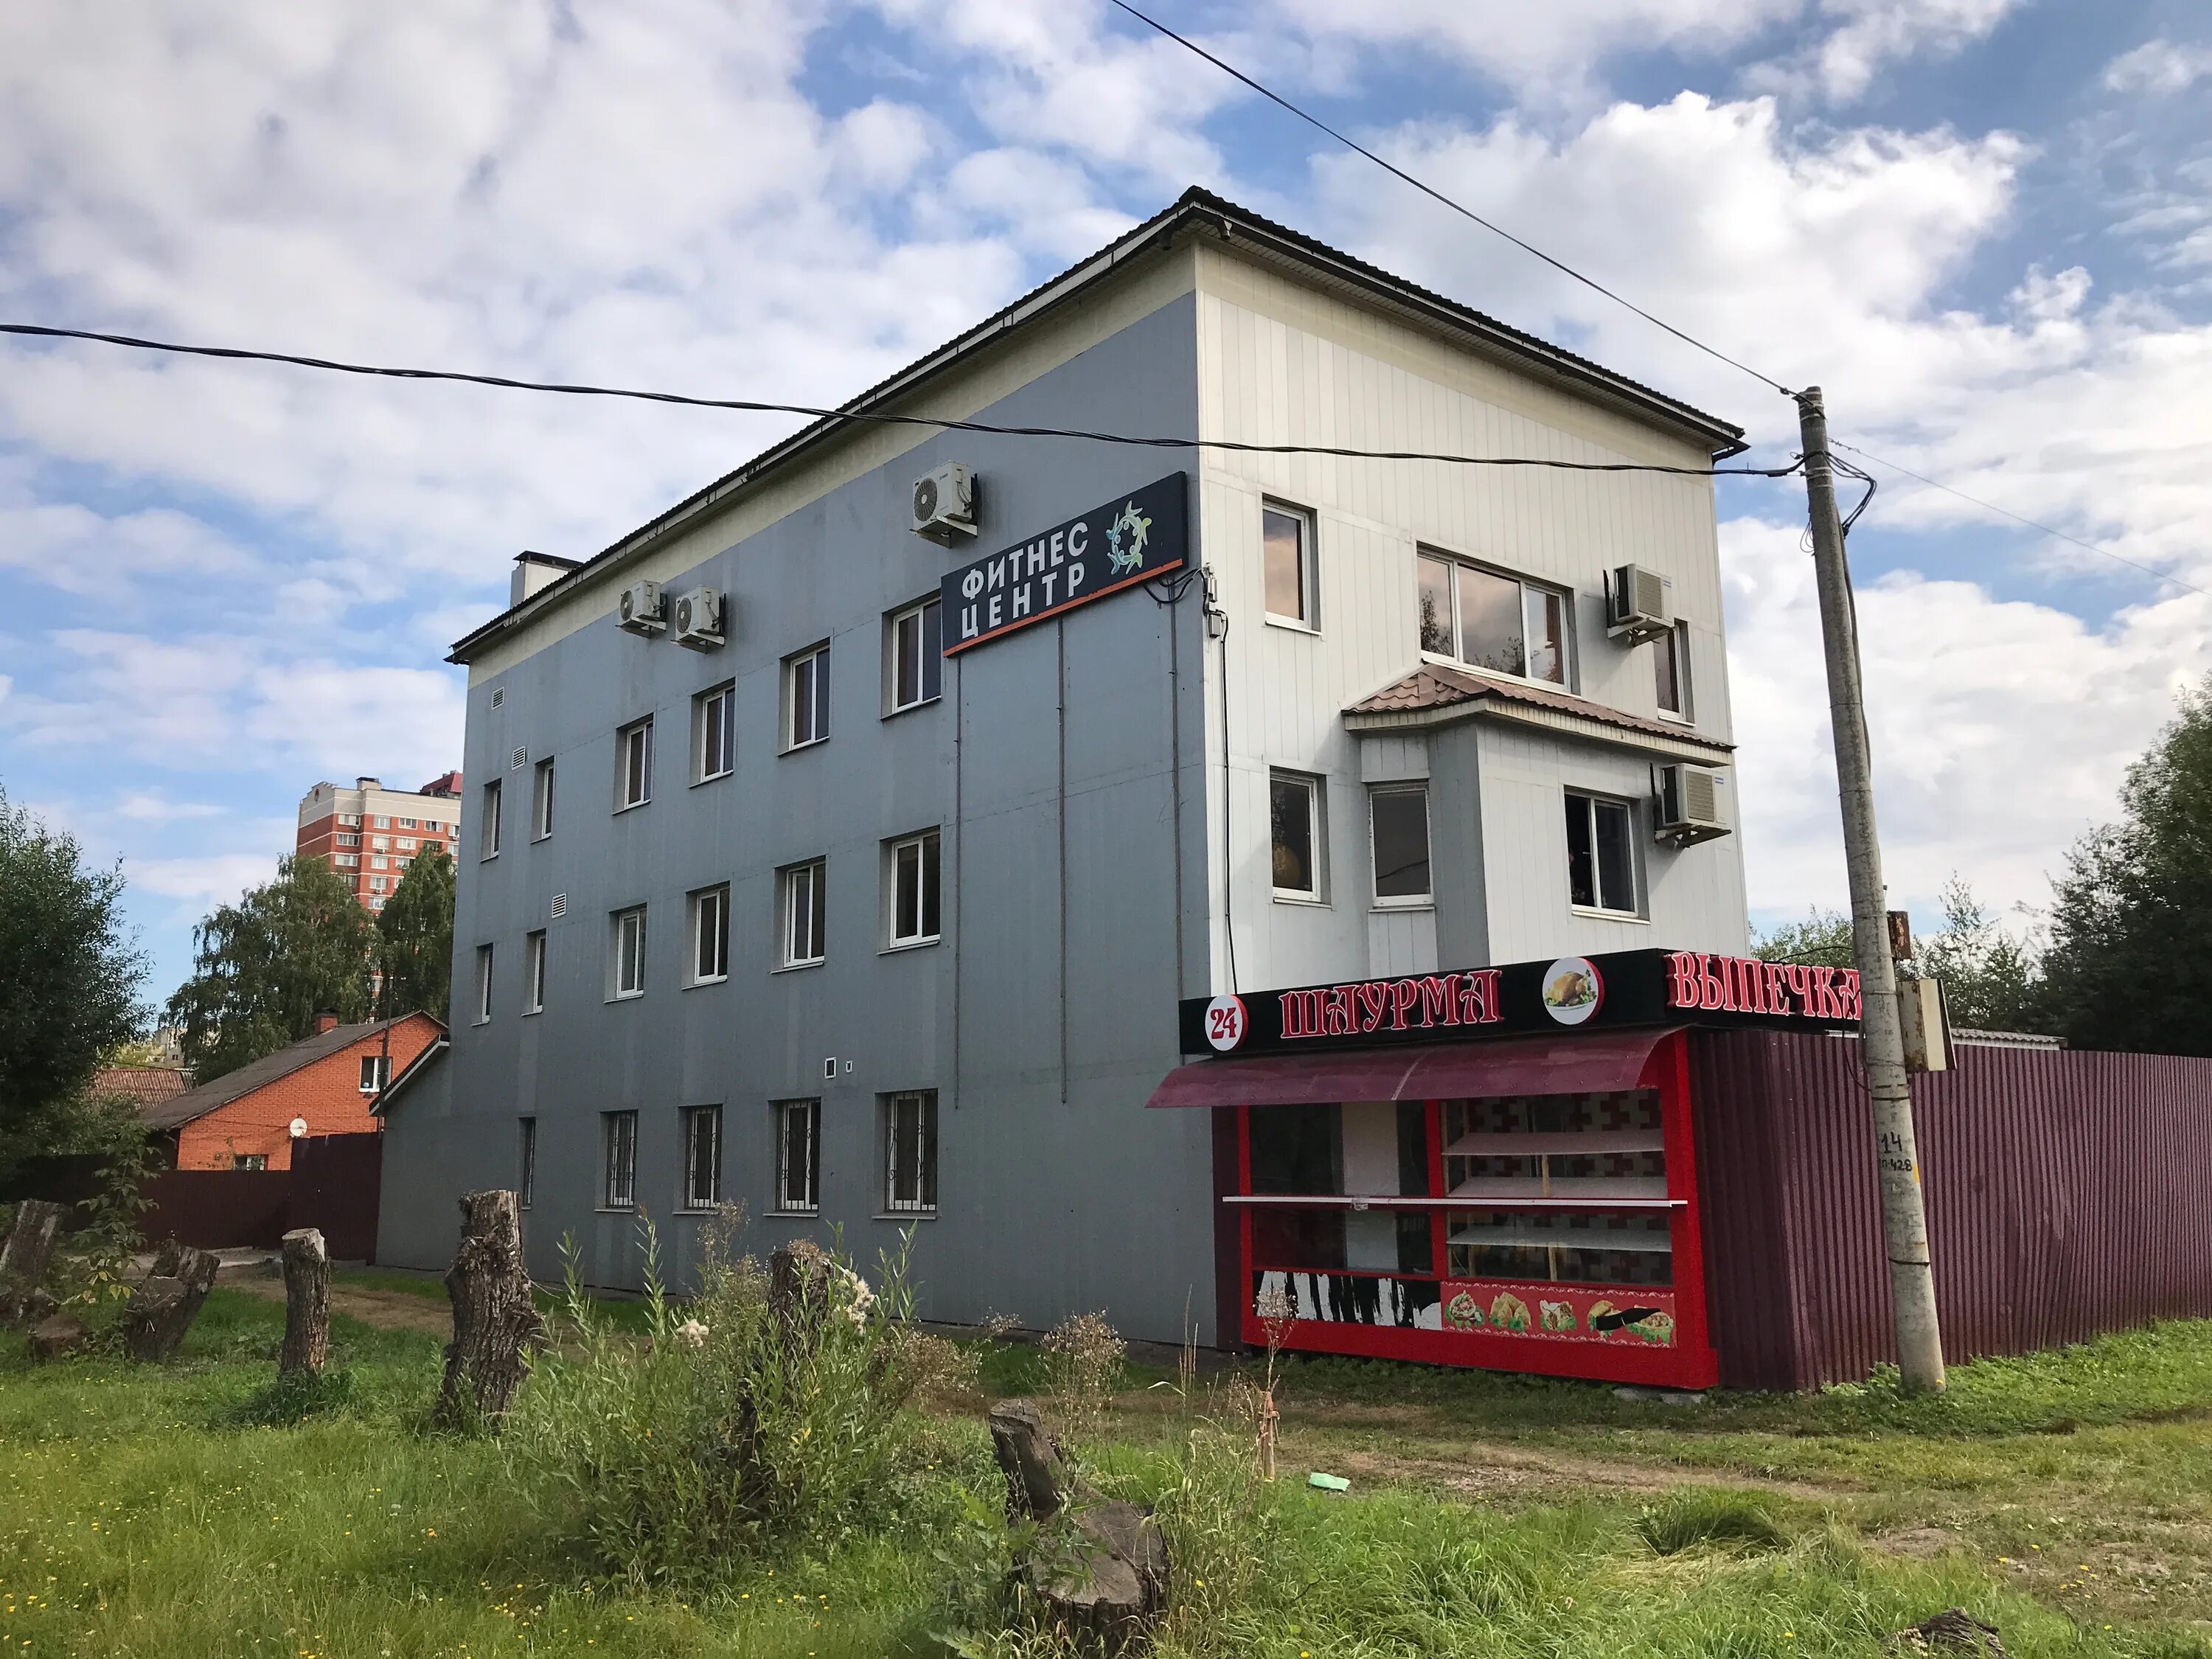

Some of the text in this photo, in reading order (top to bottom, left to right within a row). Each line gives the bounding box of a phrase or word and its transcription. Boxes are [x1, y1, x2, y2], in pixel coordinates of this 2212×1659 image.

[961, 521, 1088, 599] ФИТНЕС
[961, 562, 1085, 639] ЦЕНТР
[1279, 969, 1503, 1040] ШАУРМА
[1669, 951, 1862, 1020] ВЫПЕЧКА
[1210, 1008, 1237, 1039] 24
[1881, 1131, 1902, 1154] 14
